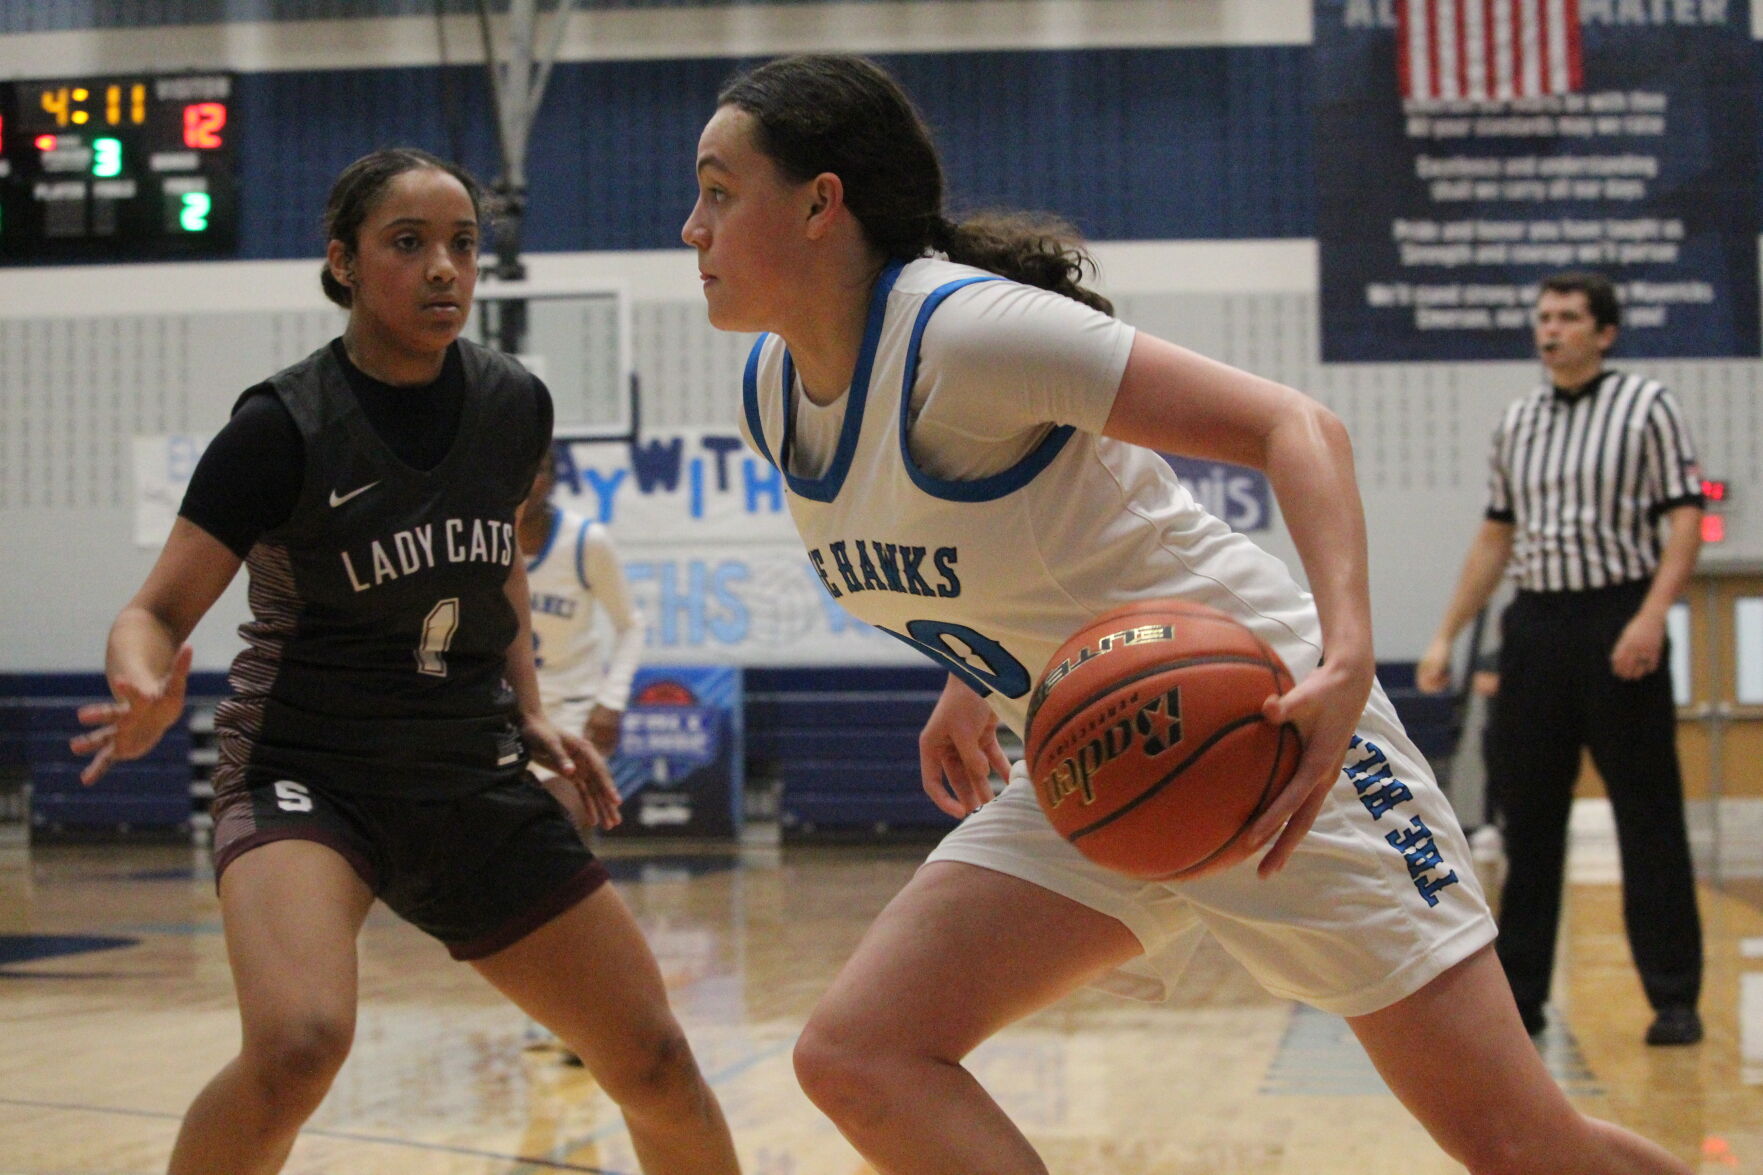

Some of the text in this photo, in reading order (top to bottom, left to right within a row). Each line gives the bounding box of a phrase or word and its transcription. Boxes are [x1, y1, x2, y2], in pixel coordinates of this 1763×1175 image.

[1343, 0, 1398, 28] AL
[41, 83, 146, 128] 4:11
[183, 102, 227, 149] 12
[92, 136, 122, 178] 3
[179, 191, 212, 233] 2
[551, 435, 782, 524] AY WITH
[340, 518, 513, 593] LADY CATS
[829, 539, 962, 599] HAWKS
[413, 597, 460, 679] 1
[1042, 683, 1185, 810] Baden
[273, 779, 314, 814] S
[1342, 734, 1460, 909] THE HIL
